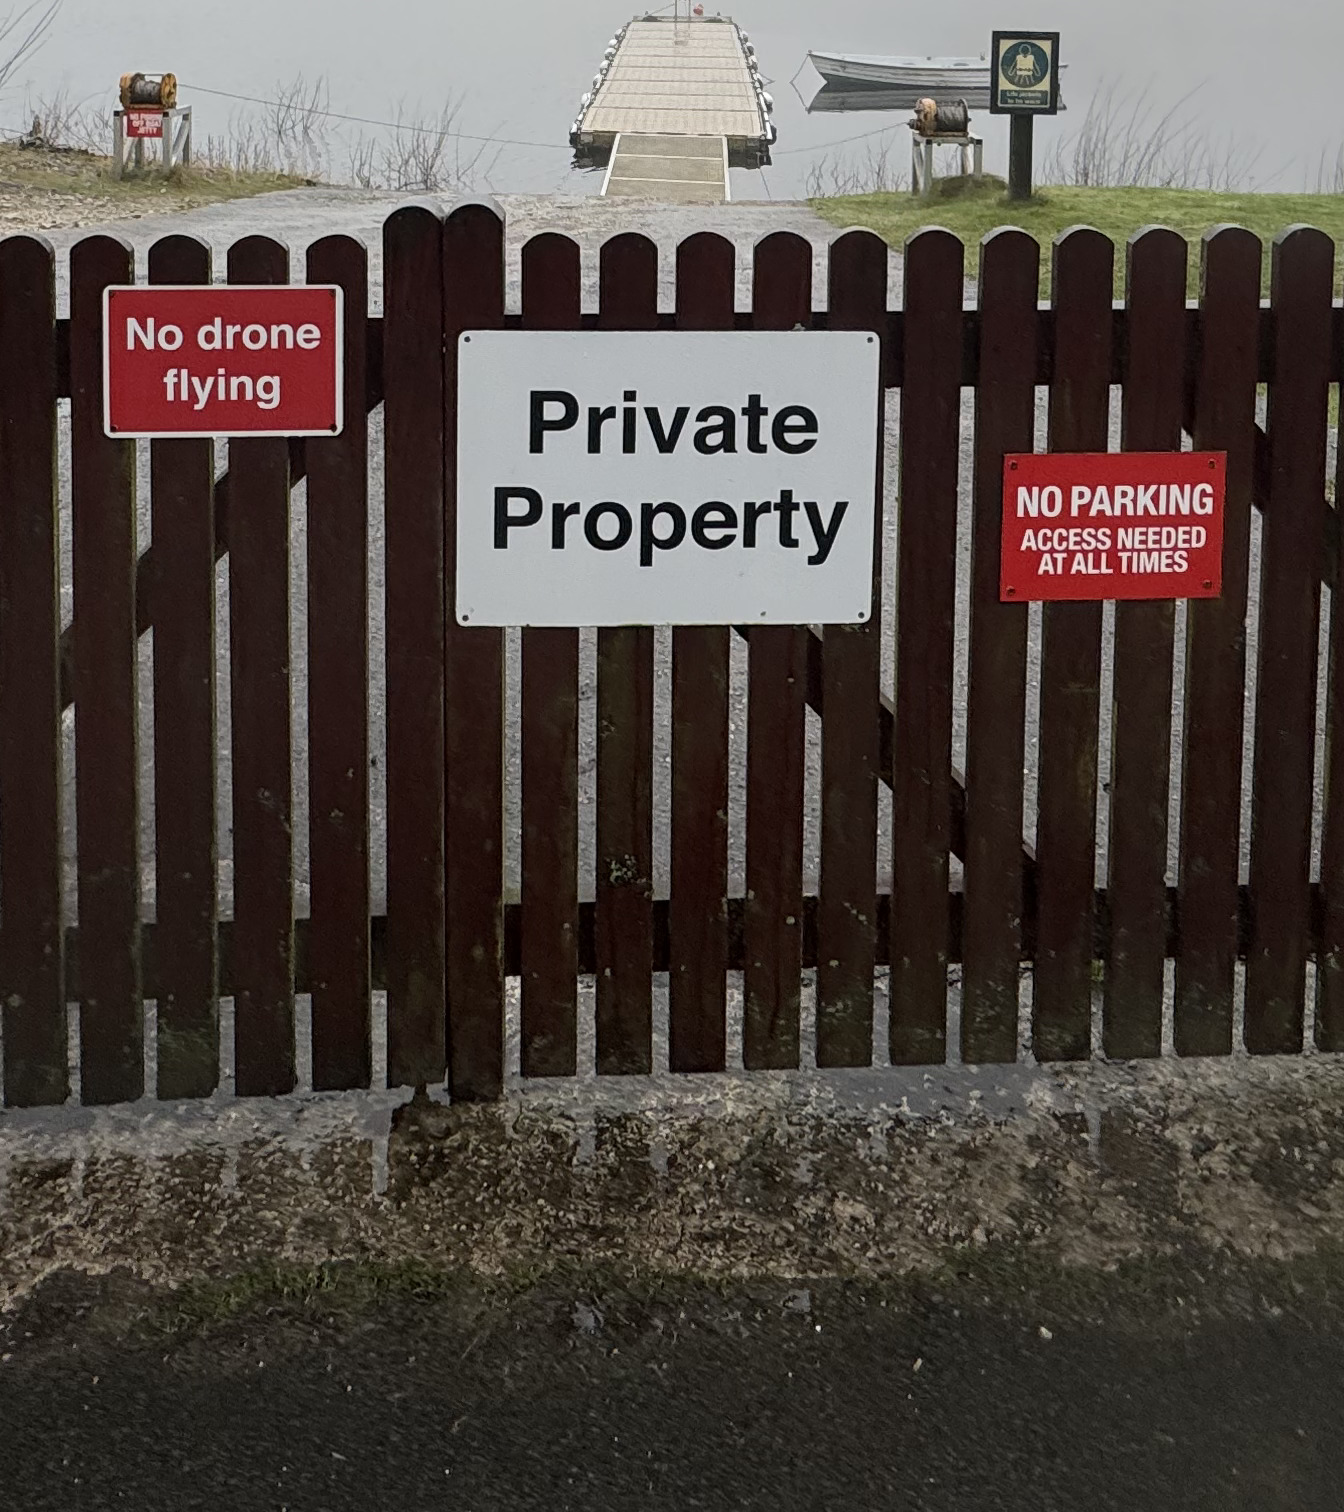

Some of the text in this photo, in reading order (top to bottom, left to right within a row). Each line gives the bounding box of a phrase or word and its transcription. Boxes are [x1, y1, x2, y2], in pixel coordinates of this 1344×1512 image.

[127, 317, 321, 351] No drone
[163, 368, 280, 410] flying
[529, 390, 818, 454] Private
[1017, 483, 1213, 517] NO PARKING
[494, 486, 849, 567] Property
[1020, 526, 1206, 551] ACCESS NEEDED
[1037, 550, 1188, 575] AT ALL TIMES
